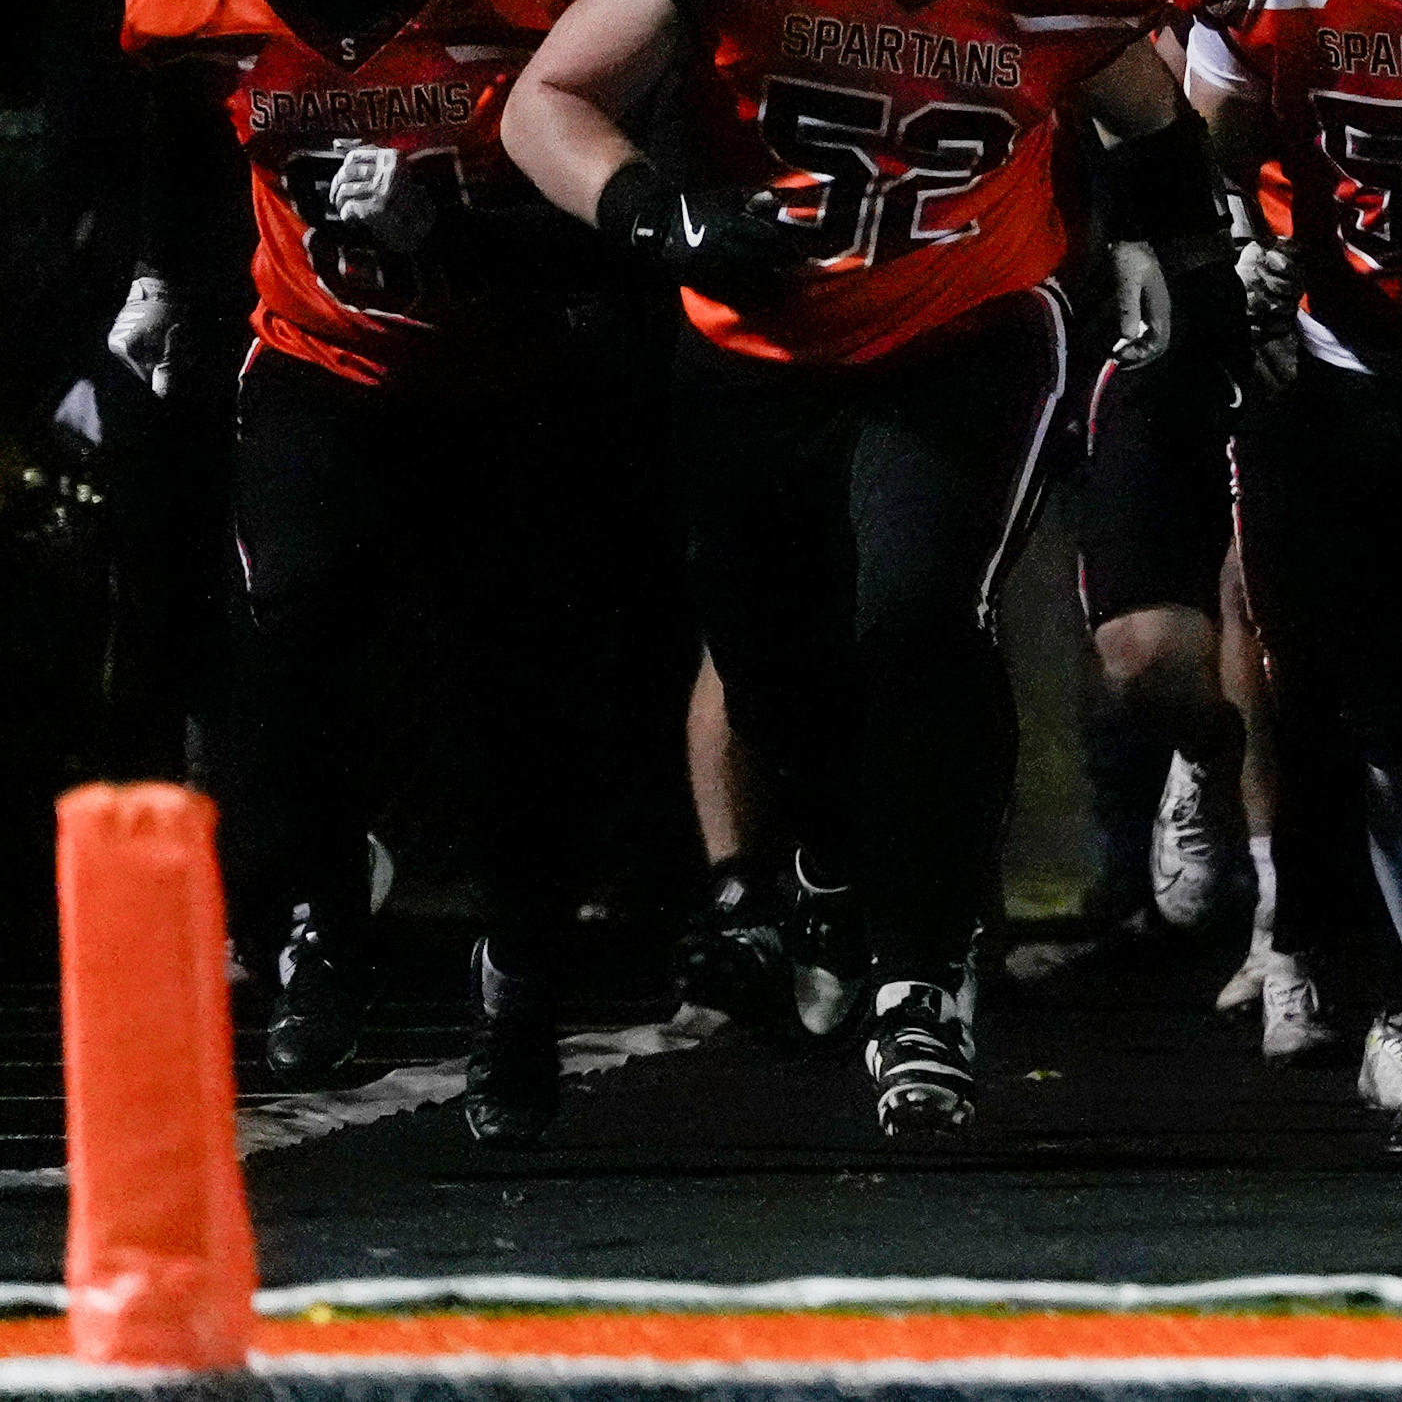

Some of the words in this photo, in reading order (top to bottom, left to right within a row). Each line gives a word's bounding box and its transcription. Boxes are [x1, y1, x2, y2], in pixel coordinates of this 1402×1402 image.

[340, 37, 356, 61] S
[781, 12, 1023, 89] SPARTANS
[249, 79, 472, 132] SPARTANS
[757, 73, 1023, 269] 52
